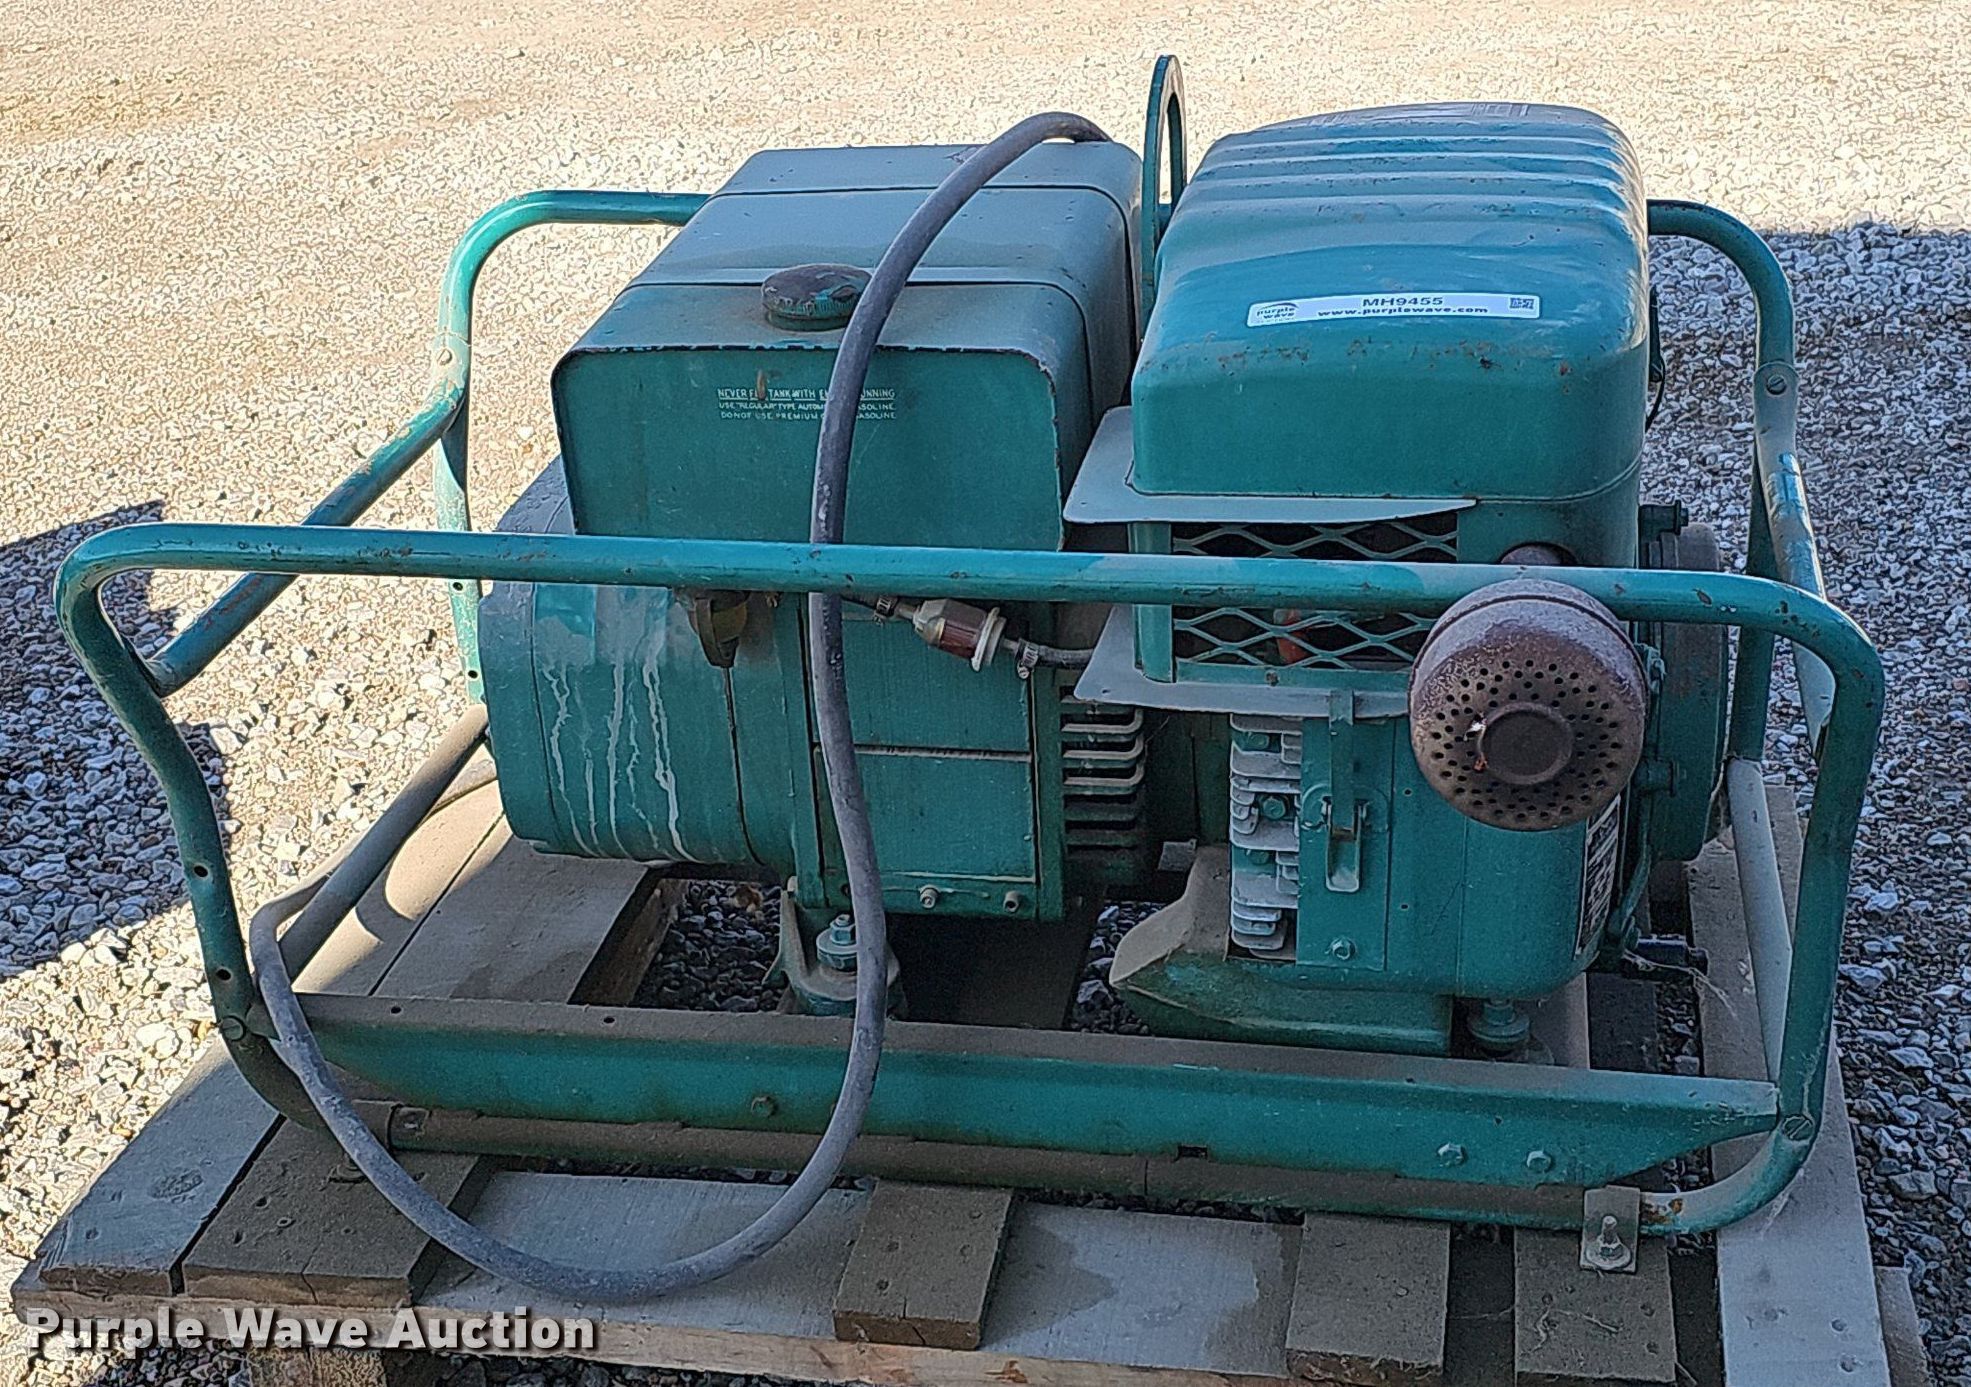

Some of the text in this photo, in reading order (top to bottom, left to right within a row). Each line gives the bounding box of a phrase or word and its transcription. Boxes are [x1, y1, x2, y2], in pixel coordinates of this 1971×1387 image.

[1362, 296, 1443, 307] MH9455
[1317, 306, 1489, 317] www.purplewave.com
[717, 388, 747, 398] NEVER
[768, 388, 791, 398] TANK
[860, 388, 896, 398] UNNING
[777, 402, 796, 410] TYPE
